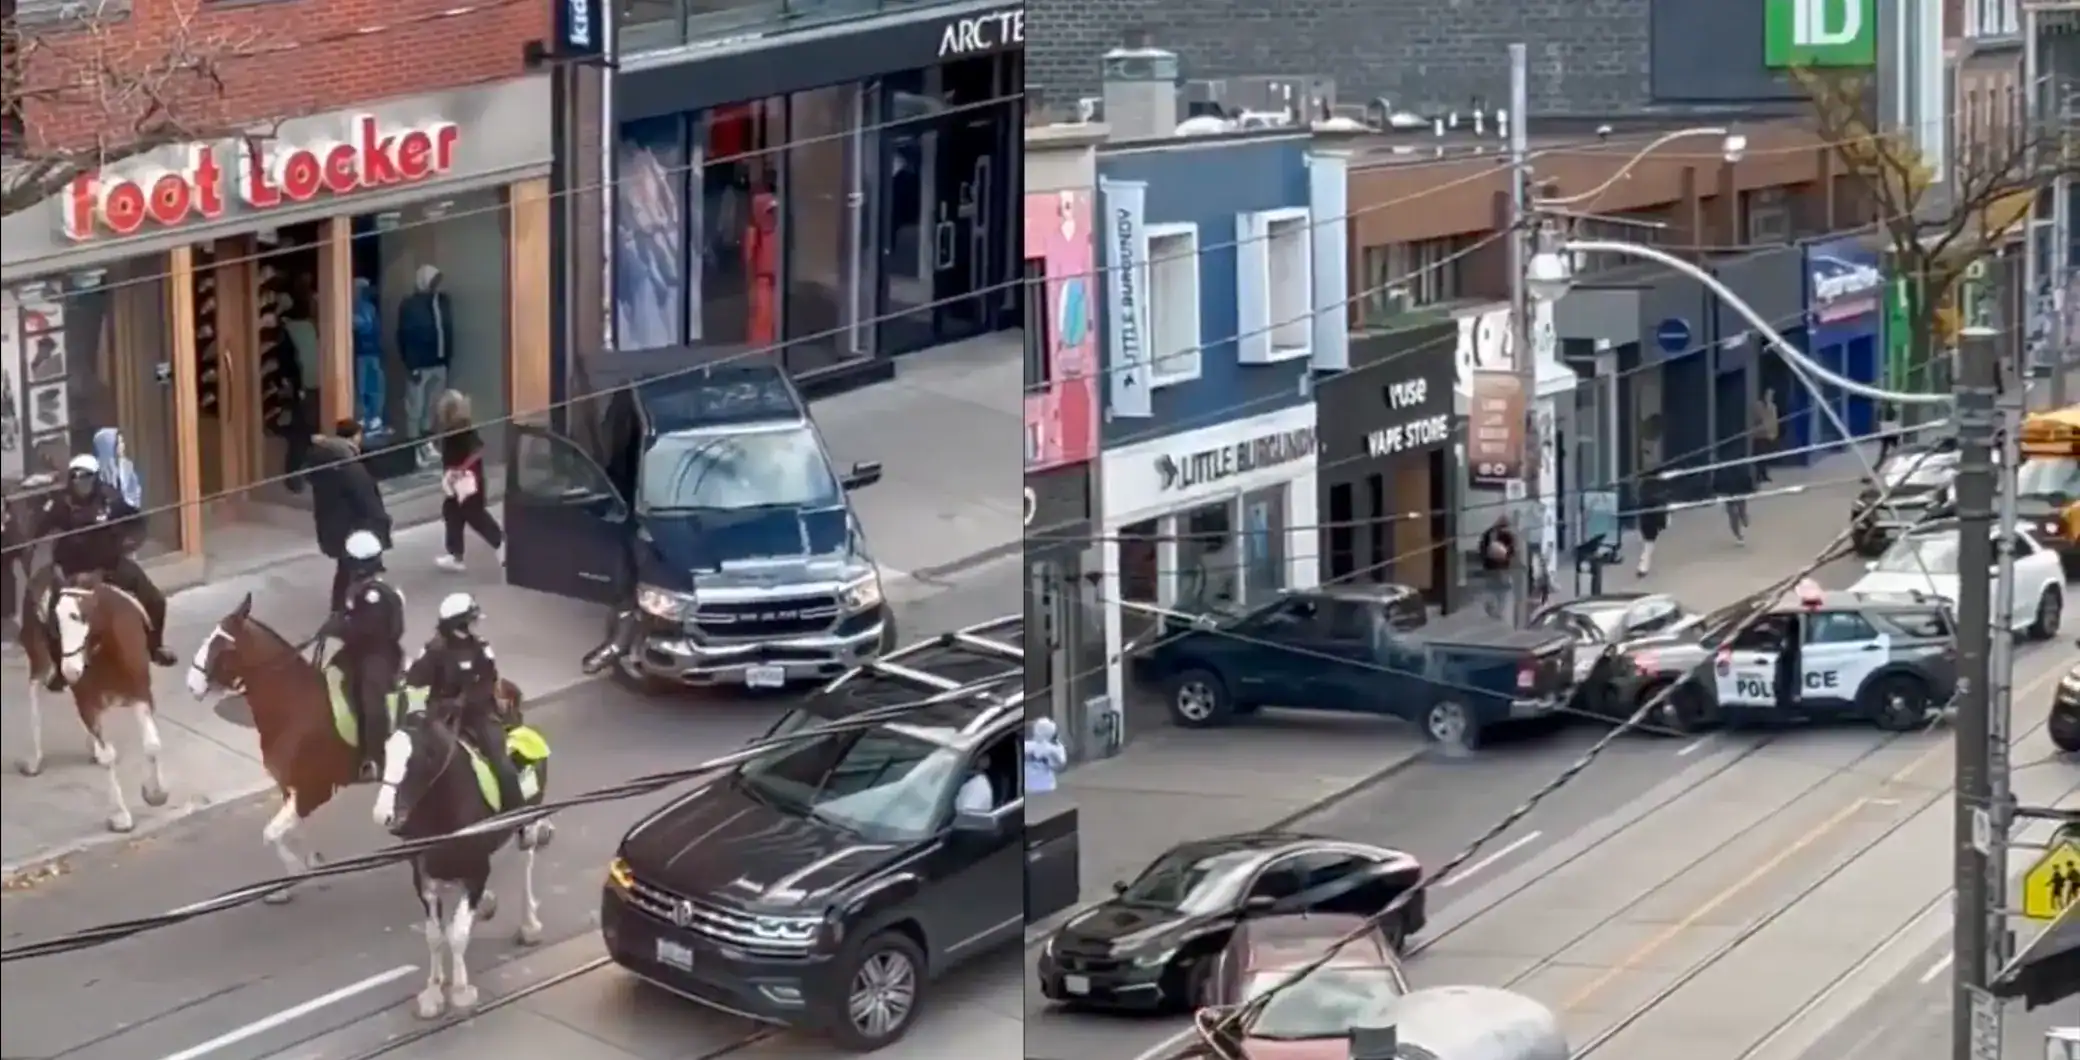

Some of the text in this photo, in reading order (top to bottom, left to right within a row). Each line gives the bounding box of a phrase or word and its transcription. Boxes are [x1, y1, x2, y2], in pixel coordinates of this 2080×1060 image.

[239, 113, 460, 207] Locker
[1368, 425, 1403, 459] VAPE
[1405, 414, 1448, 448] STORE
[1179, 446, 1236, 489] LITTLE
[1736, 670, 1839, 698] POLCE
